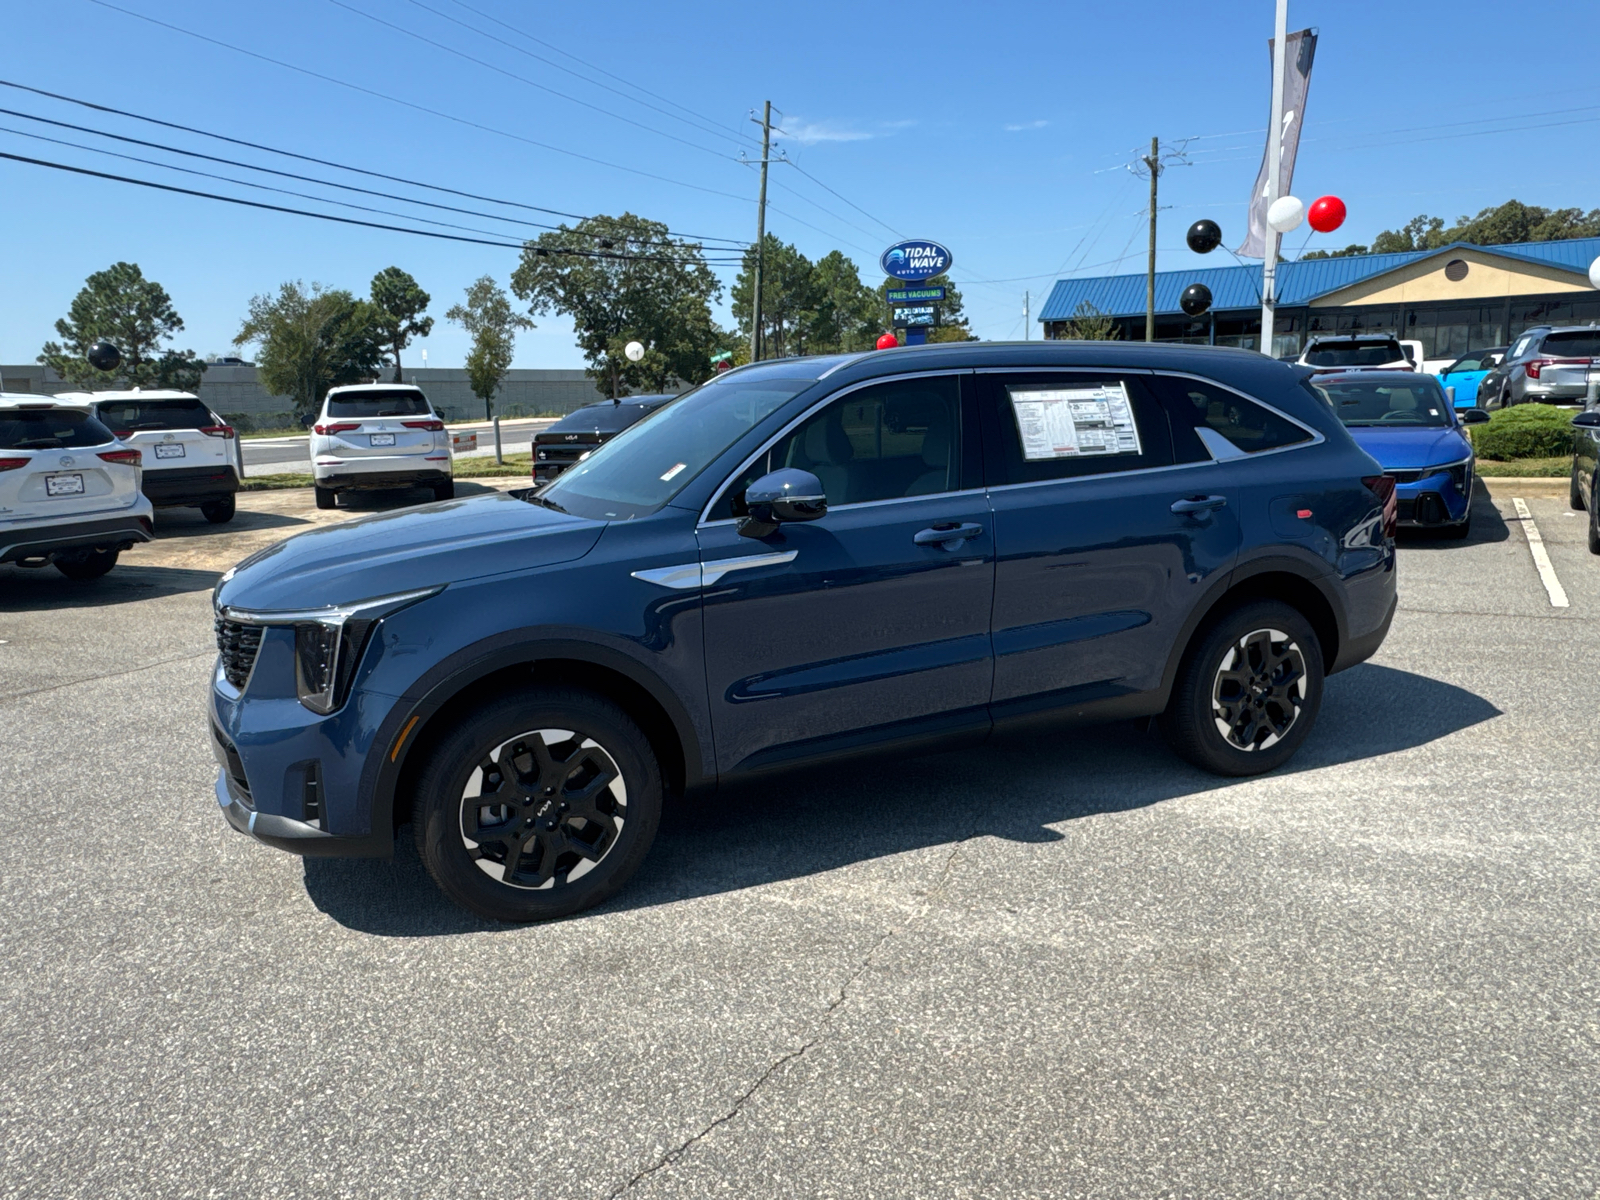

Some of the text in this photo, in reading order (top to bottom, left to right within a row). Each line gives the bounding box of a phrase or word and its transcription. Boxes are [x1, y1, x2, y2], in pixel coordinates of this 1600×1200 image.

[905, 247, 937, 258] TIDAL
[910, 257, 944, 268] WAVE
[888, 289, 941, 299] FREE VACUUMS
